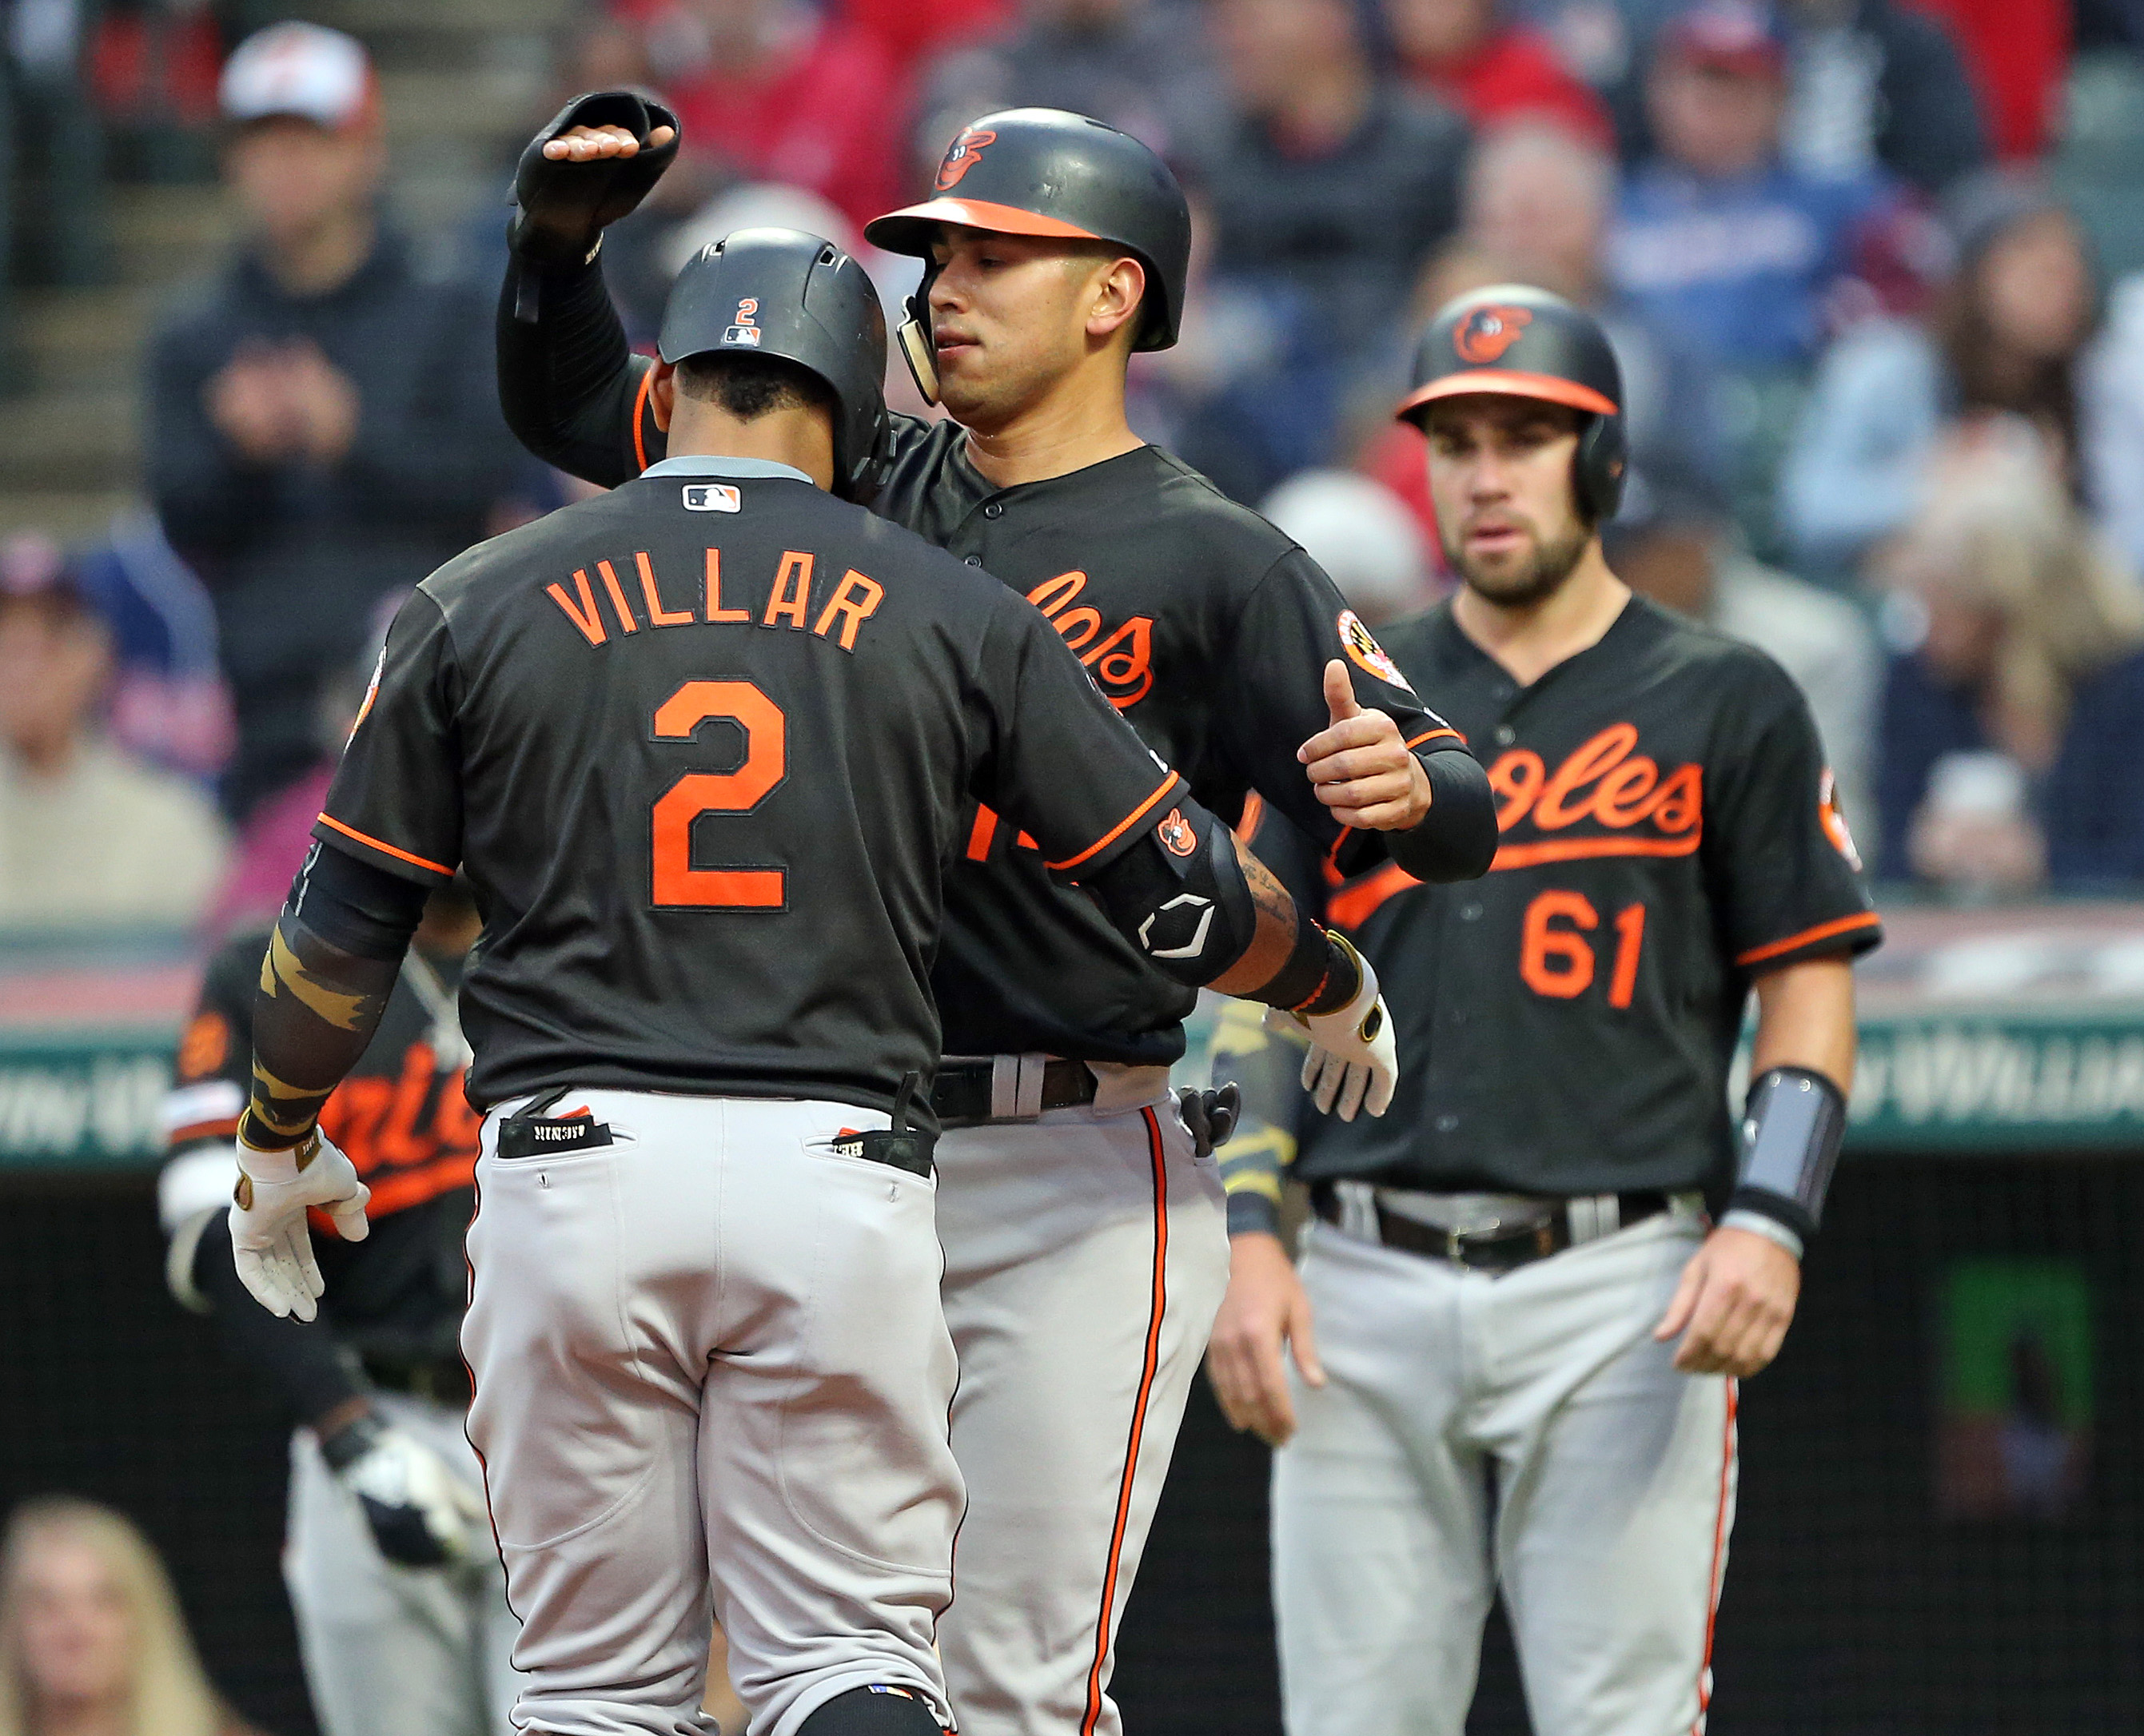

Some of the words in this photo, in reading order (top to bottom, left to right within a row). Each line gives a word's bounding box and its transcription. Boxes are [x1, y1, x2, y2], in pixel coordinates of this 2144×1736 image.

[735, 297, 759, 326] 2
[545, 547, 886, 652] VILLAR
[651, 680, 786, 907] 2
[1486, 723, 1703, 847] oles
[1520, 889, 1645, 1009] 61
